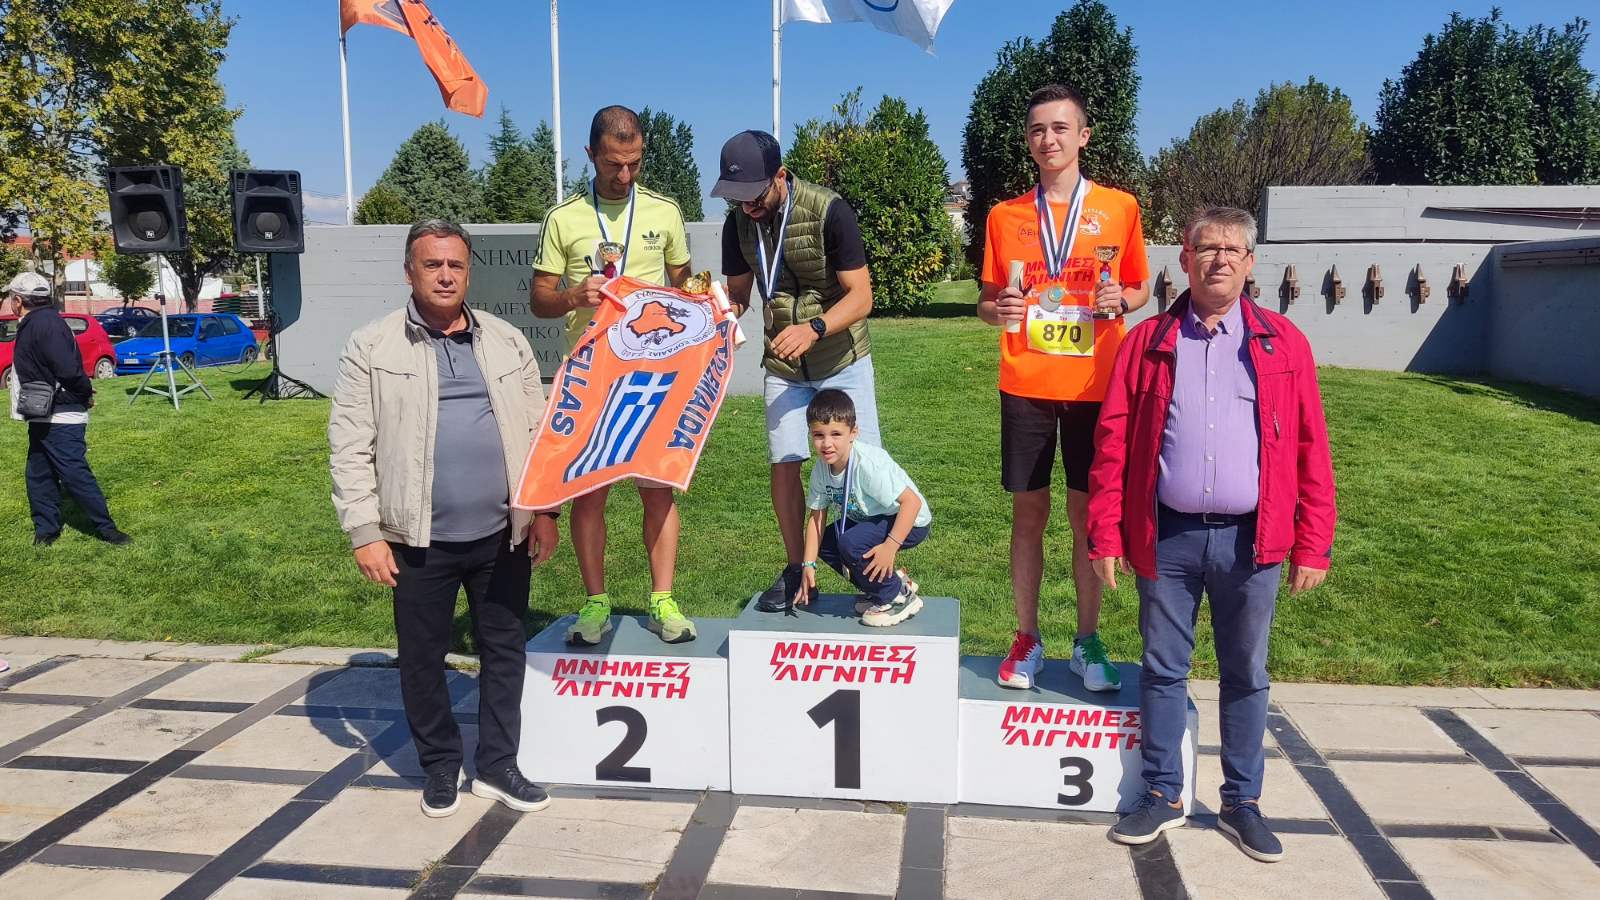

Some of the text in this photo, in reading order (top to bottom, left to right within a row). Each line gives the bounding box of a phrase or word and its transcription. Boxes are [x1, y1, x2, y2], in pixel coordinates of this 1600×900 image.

[1042, 324, 1082, 343] 870
[770, 642, 917, 664] ΜΝΗΜΕΣ
[552, 658, 691, 680] ΜΝΗΜΕΣ
[771, 662, 916, 684] ΛΙΓΝΙΤΗ
[553, 677, 690, 699] ΛΙΓΝΙΤΗ
[1001, 706, 1142, 728] ΜΝΗΜΕΣ
[595, 705, 652, 783] 2
[806, 689, 861, 789] 1
[1057, 756, 1094, 806] 3
